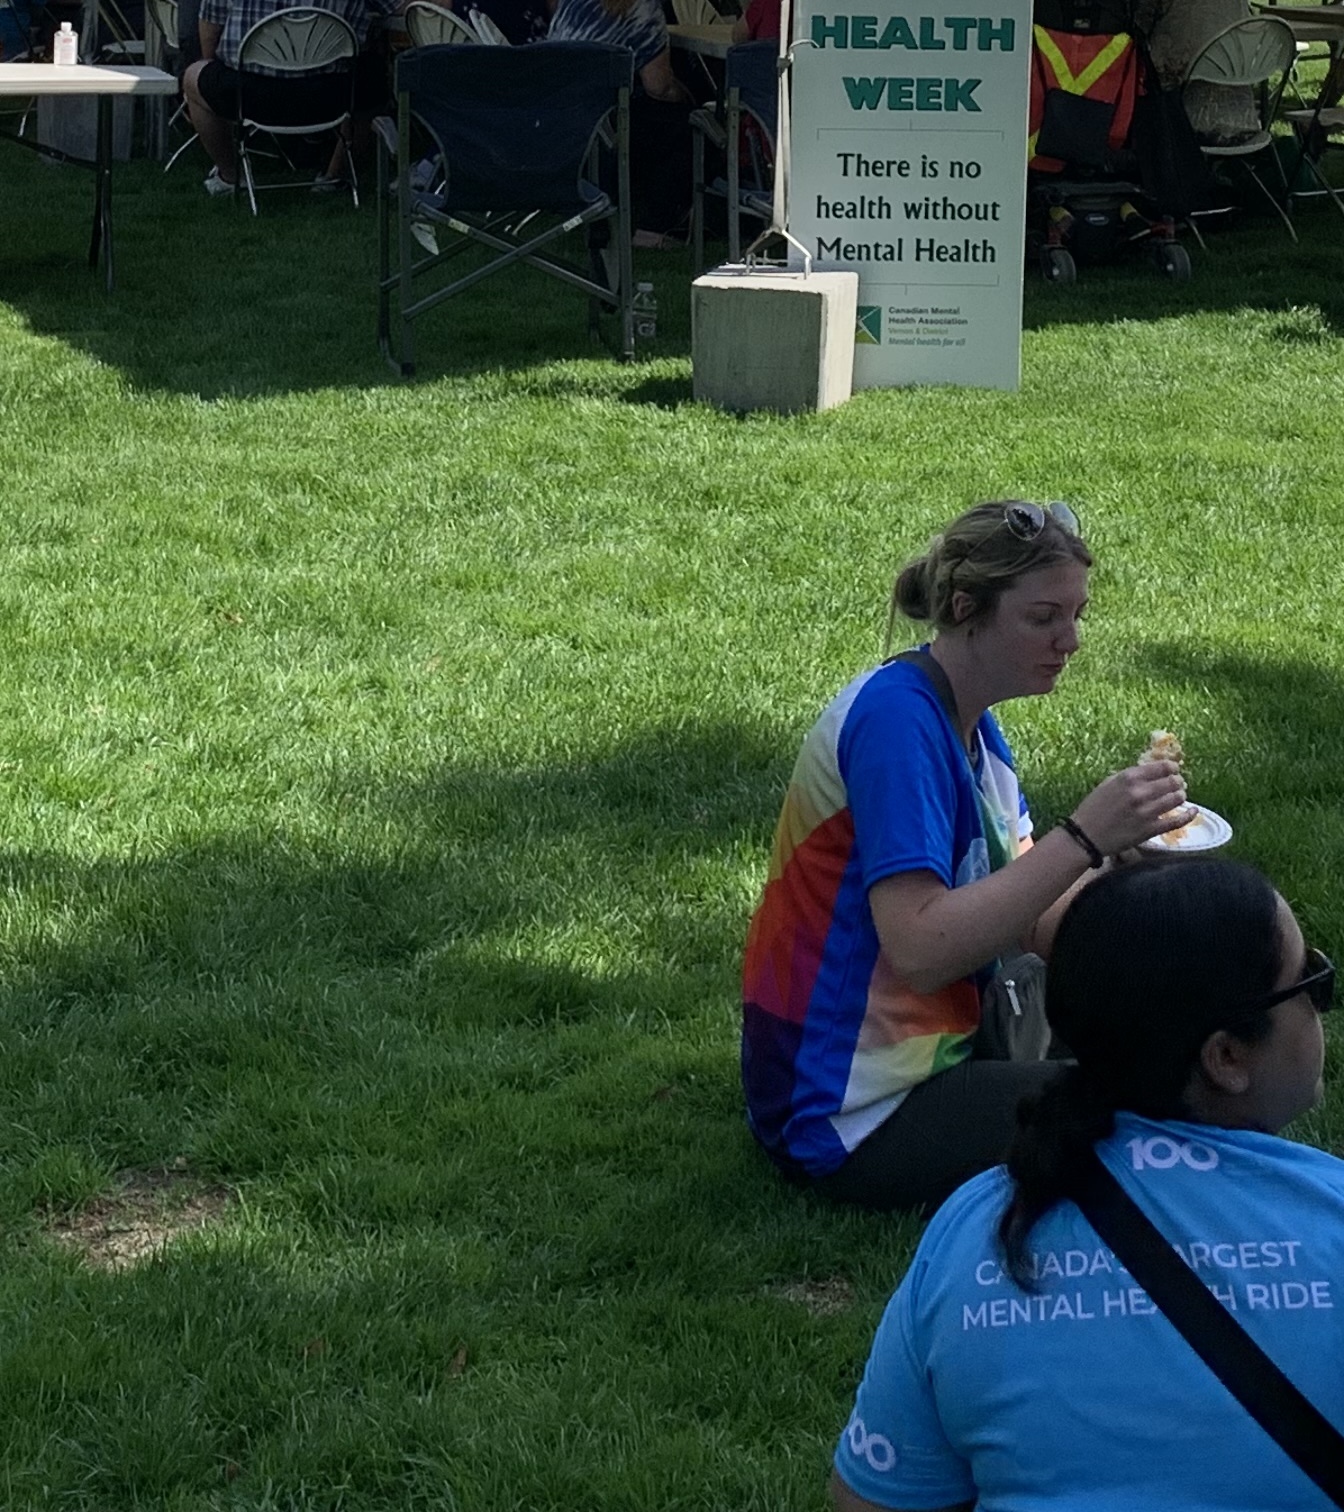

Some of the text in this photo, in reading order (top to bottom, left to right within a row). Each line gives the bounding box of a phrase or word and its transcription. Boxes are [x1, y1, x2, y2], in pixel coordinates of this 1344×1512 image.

[810, 15, 1015, 52] HEALTH
[841, 76, 982, 112] WEEK
[836, 153, 982, 179] There is no
[816, 195, 1001, 221] health without
[816, 237, 996, 263] Mental Health
[888, 306, 960, 315] Canadian Mental
[917, 317, 968, 325] Association
[1126, 1136, 1220, 1171] 100
[975, 1241, 1301, 1286] CADA' RGEST
[962, 1281, 1334, 1330] MENTAL HEH RIDE
[848, 1417, 896, 1472] 00
